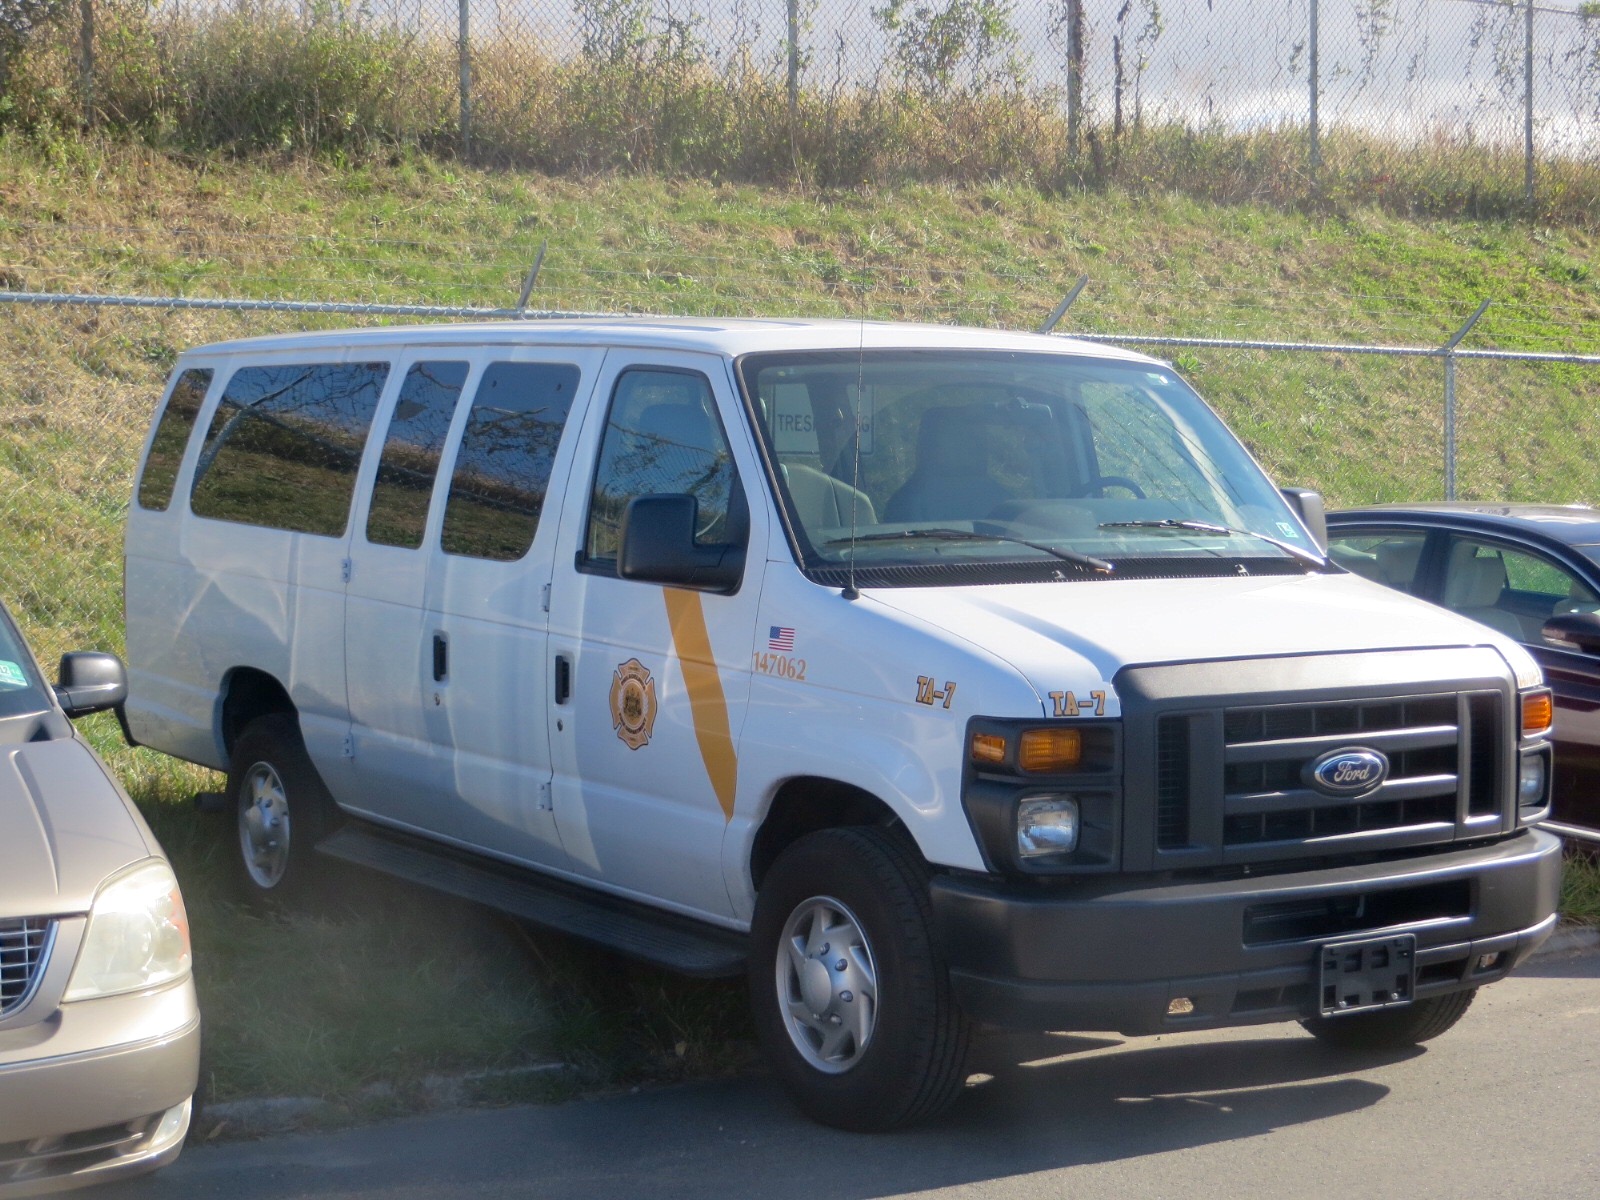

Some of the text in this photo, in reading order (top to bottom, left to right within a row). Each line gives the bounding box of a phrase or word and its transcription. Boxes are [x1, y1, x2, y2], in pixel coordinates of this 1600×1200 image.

[753, 651, 806, 680] 147062
[916, 675, 957, 709] TA-7
[1048, 691, 1105, 717] TA-7
[1333, 760, 1371, 783] Ford
